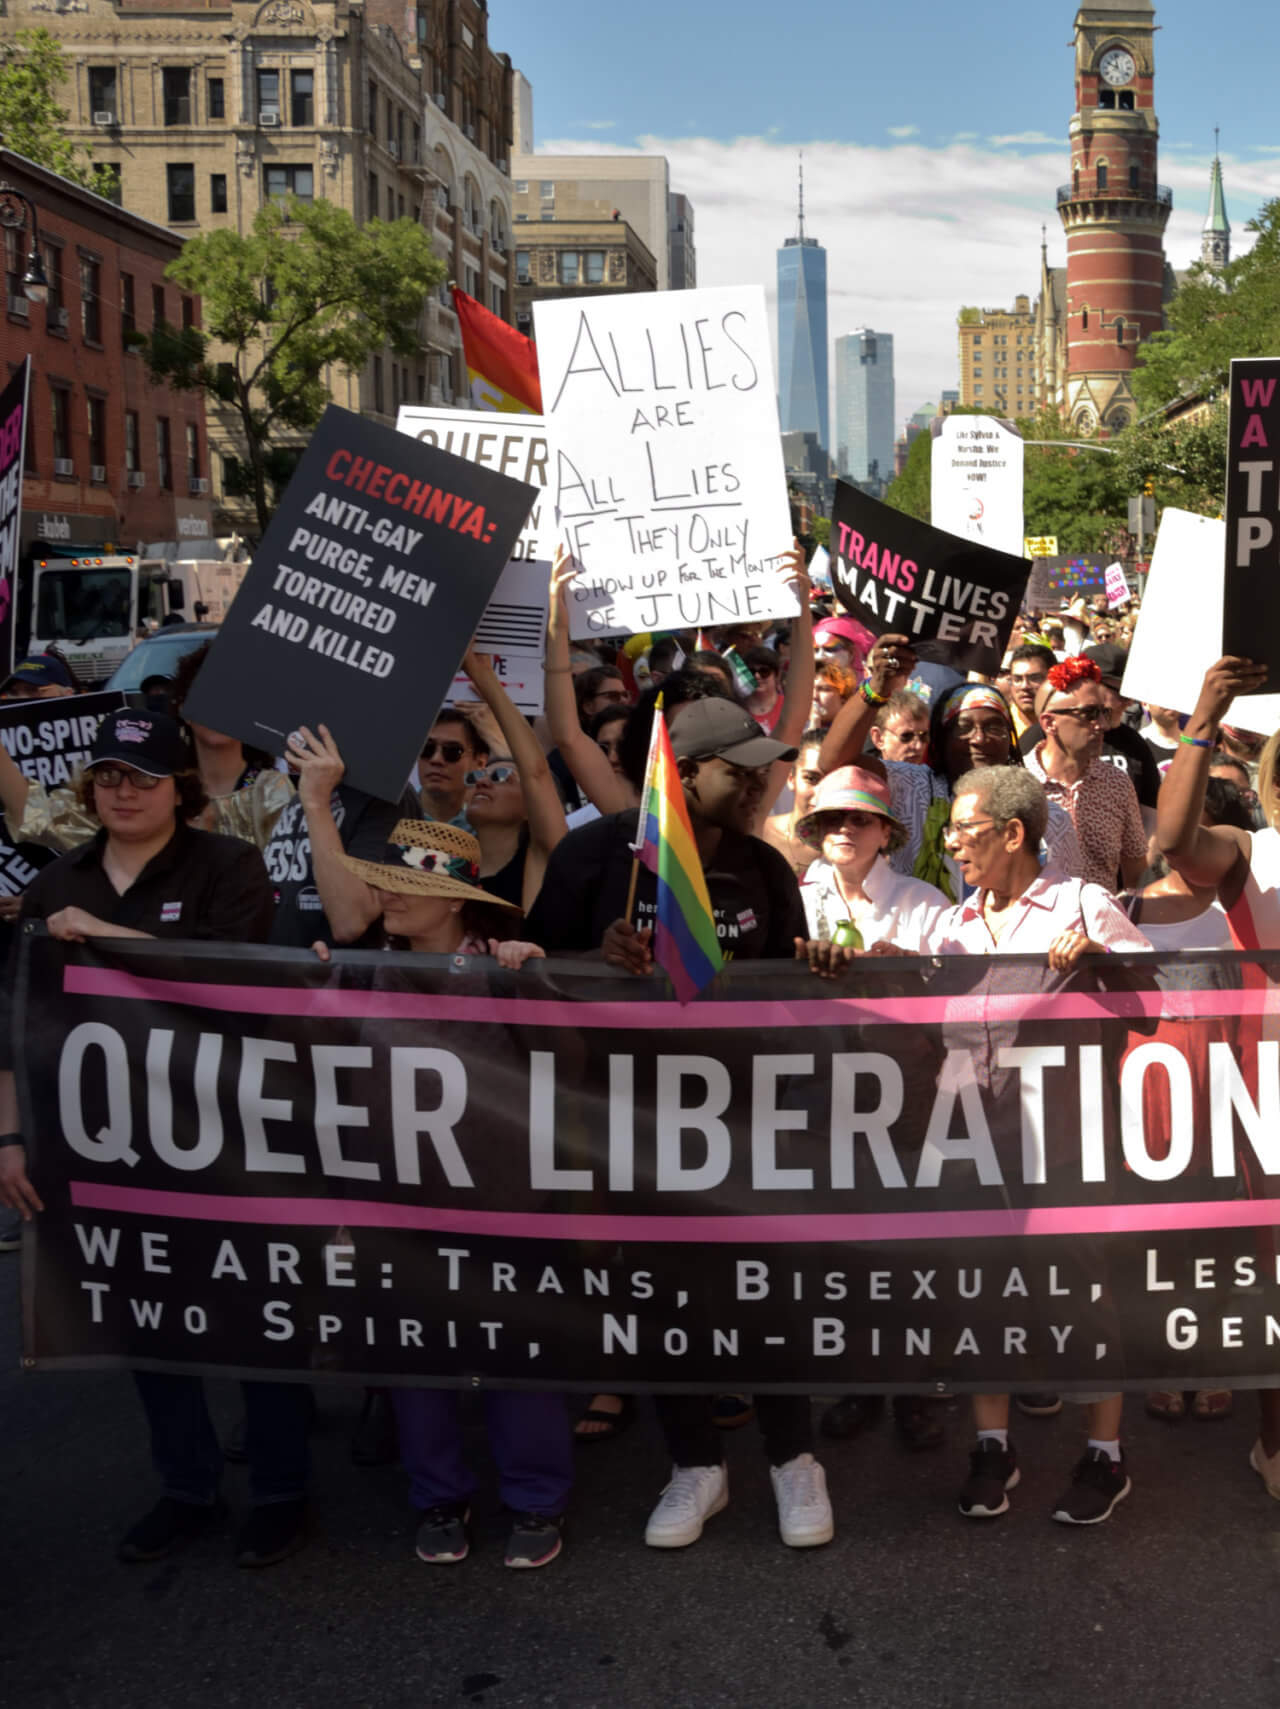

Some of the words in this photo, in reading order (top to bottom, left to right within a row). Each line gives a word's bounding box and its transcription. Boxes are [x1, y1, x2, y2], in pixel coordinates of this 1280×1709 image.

[551, 310, 758, 413] ALLIES
[631, 401, 694, 434] ARE
[326, 449, 496, 544] CHECHNYA:
[556, 449, 625, 510] ALL
[646, 441, 740, 501] LIES
[305, 492, 423, 555] ANTI-GAY
[565, 521, 594, 568] IF
[614, 516, 680, 560] THEY
[689, 513, 748, 557] ONLY
[273, 564, 397, 635] TORTURED
[288, 528, 374, 587] PURGE,
[379, 565, 437, 606] MEN
[642, 571, 668, 588] UP
[730, 554, 783, 578] MONT
[837, 521, 918, 592] TRANS
[921, 568, 1009, 620] LIVES
[837, 556, 999, 649] MATTER
[251, 603, 309, 643] AND
[308, 625, 395, 679] KILLED
[587, 608, 616, 632] OF
[636, 585, 772, 627] JUNE.
[58, 1021, 475, 1189] QUEER
[74, 1223, 172, 1275] WE
[211, 1239, 394, 1289] ARE:
[438, 1248, 689, 1307] TRANS,
[736, 1259, 1102, 1304] BISEXUAL,
[81, 1280, 208, 1336] TWO
[263, 1300, 540, 1358] SPIRIT,
